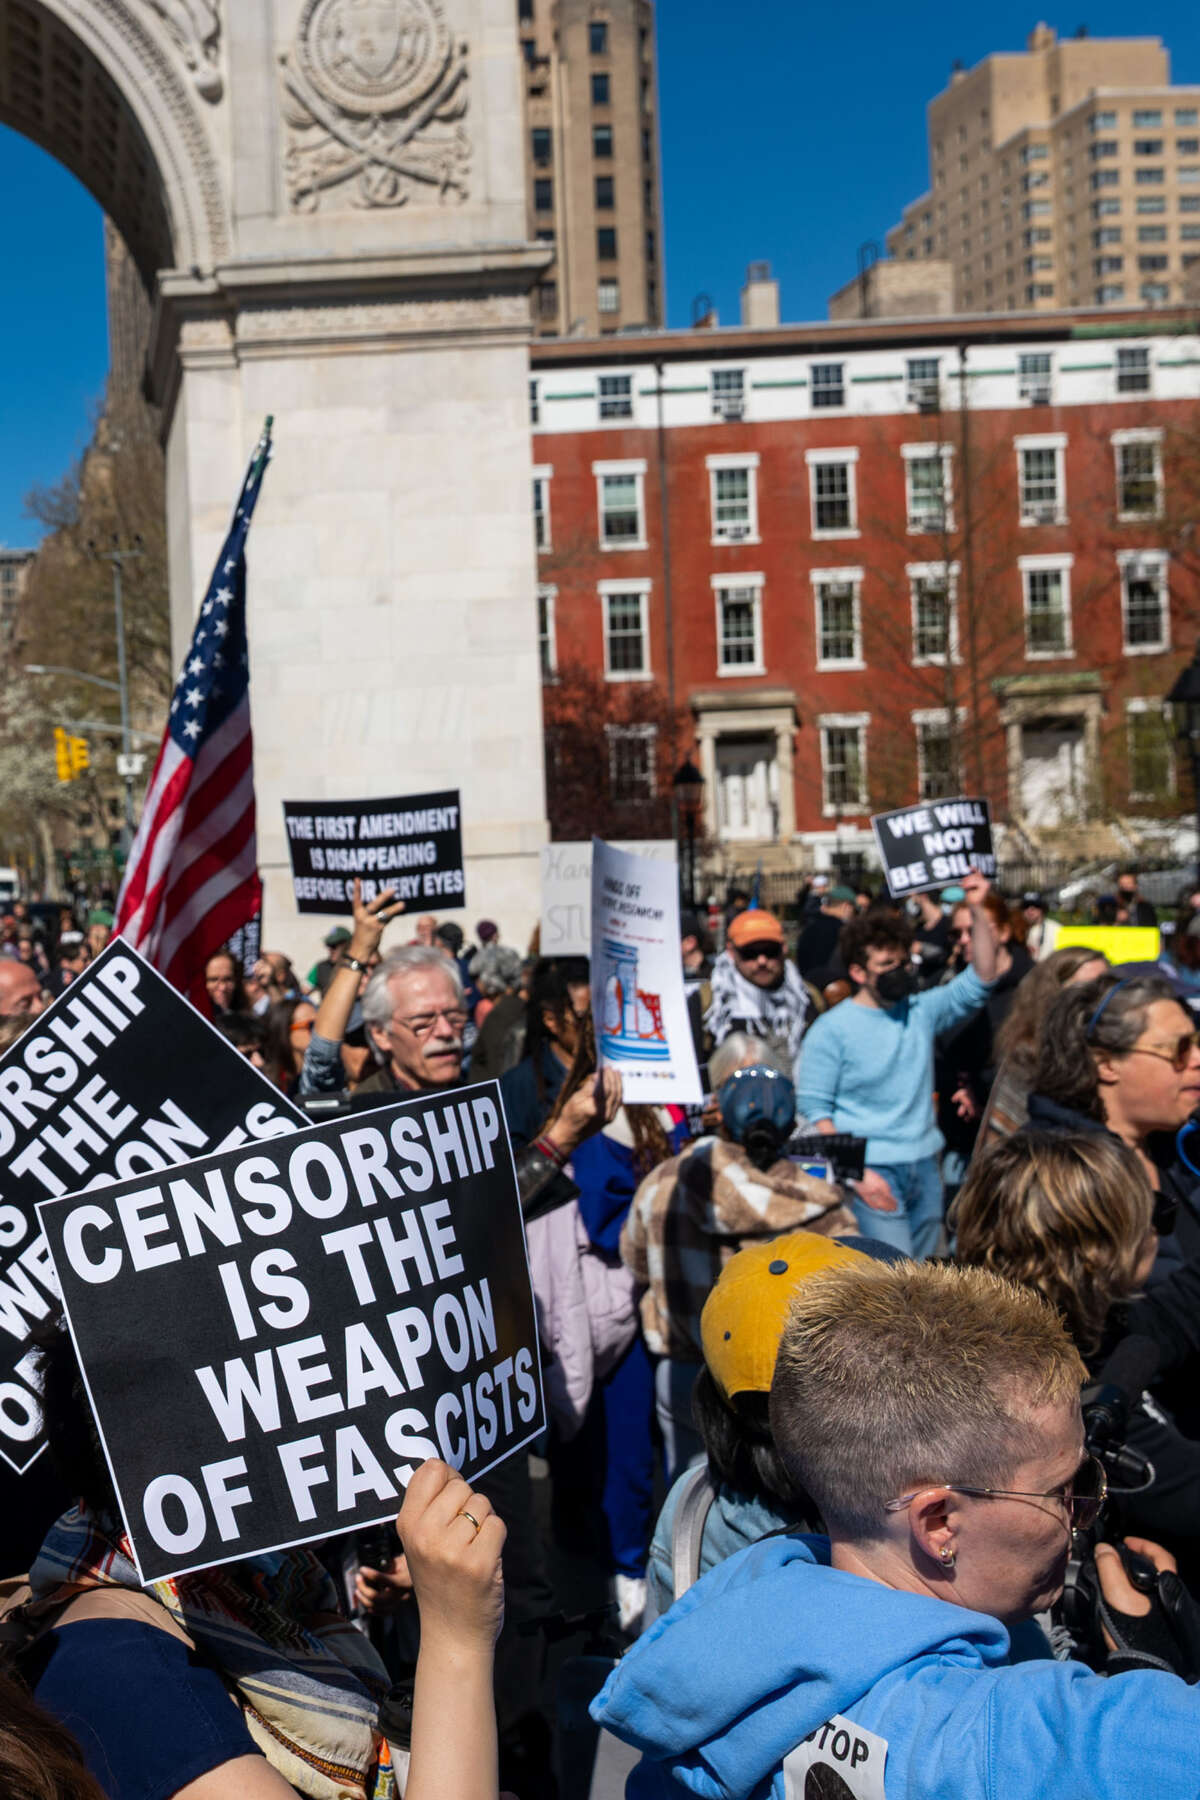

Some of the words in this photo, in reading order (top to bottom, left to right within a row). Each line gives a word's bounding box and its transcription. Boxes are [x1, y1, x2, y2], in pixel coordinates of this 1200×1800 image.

[286, 815, 315, 840] THE
[315, 815, 357, 840] FIRST
[358, 805, 459, 840] AMENDMENT
[886, 809, 933, 839] WE
[933, 802, 986, 828] WILL
[310, 847, 326, 871] IS
[326, 841, 437, 872] DISAPPEARING
[921, 827, 975, 857] NOT
[294, 876, 346, 900] BEFORE
[422, 869, 464, 896] EYES
[889, 861, 929, 890] BE
[8, 1074, 139, 1198] THE
[62, 1097, 501, 1284] CENSORSHIP
[217, 1248, 310, 1341] IS
[321, 1199, 465, 1306] THE
[194, 1278, 498, 1443] WEAPON
[143, 1456, 253, 1555] OF
[277, 1347, 538, 1522] FASCISTS
[804, 1721, 869, 1769] TOP
